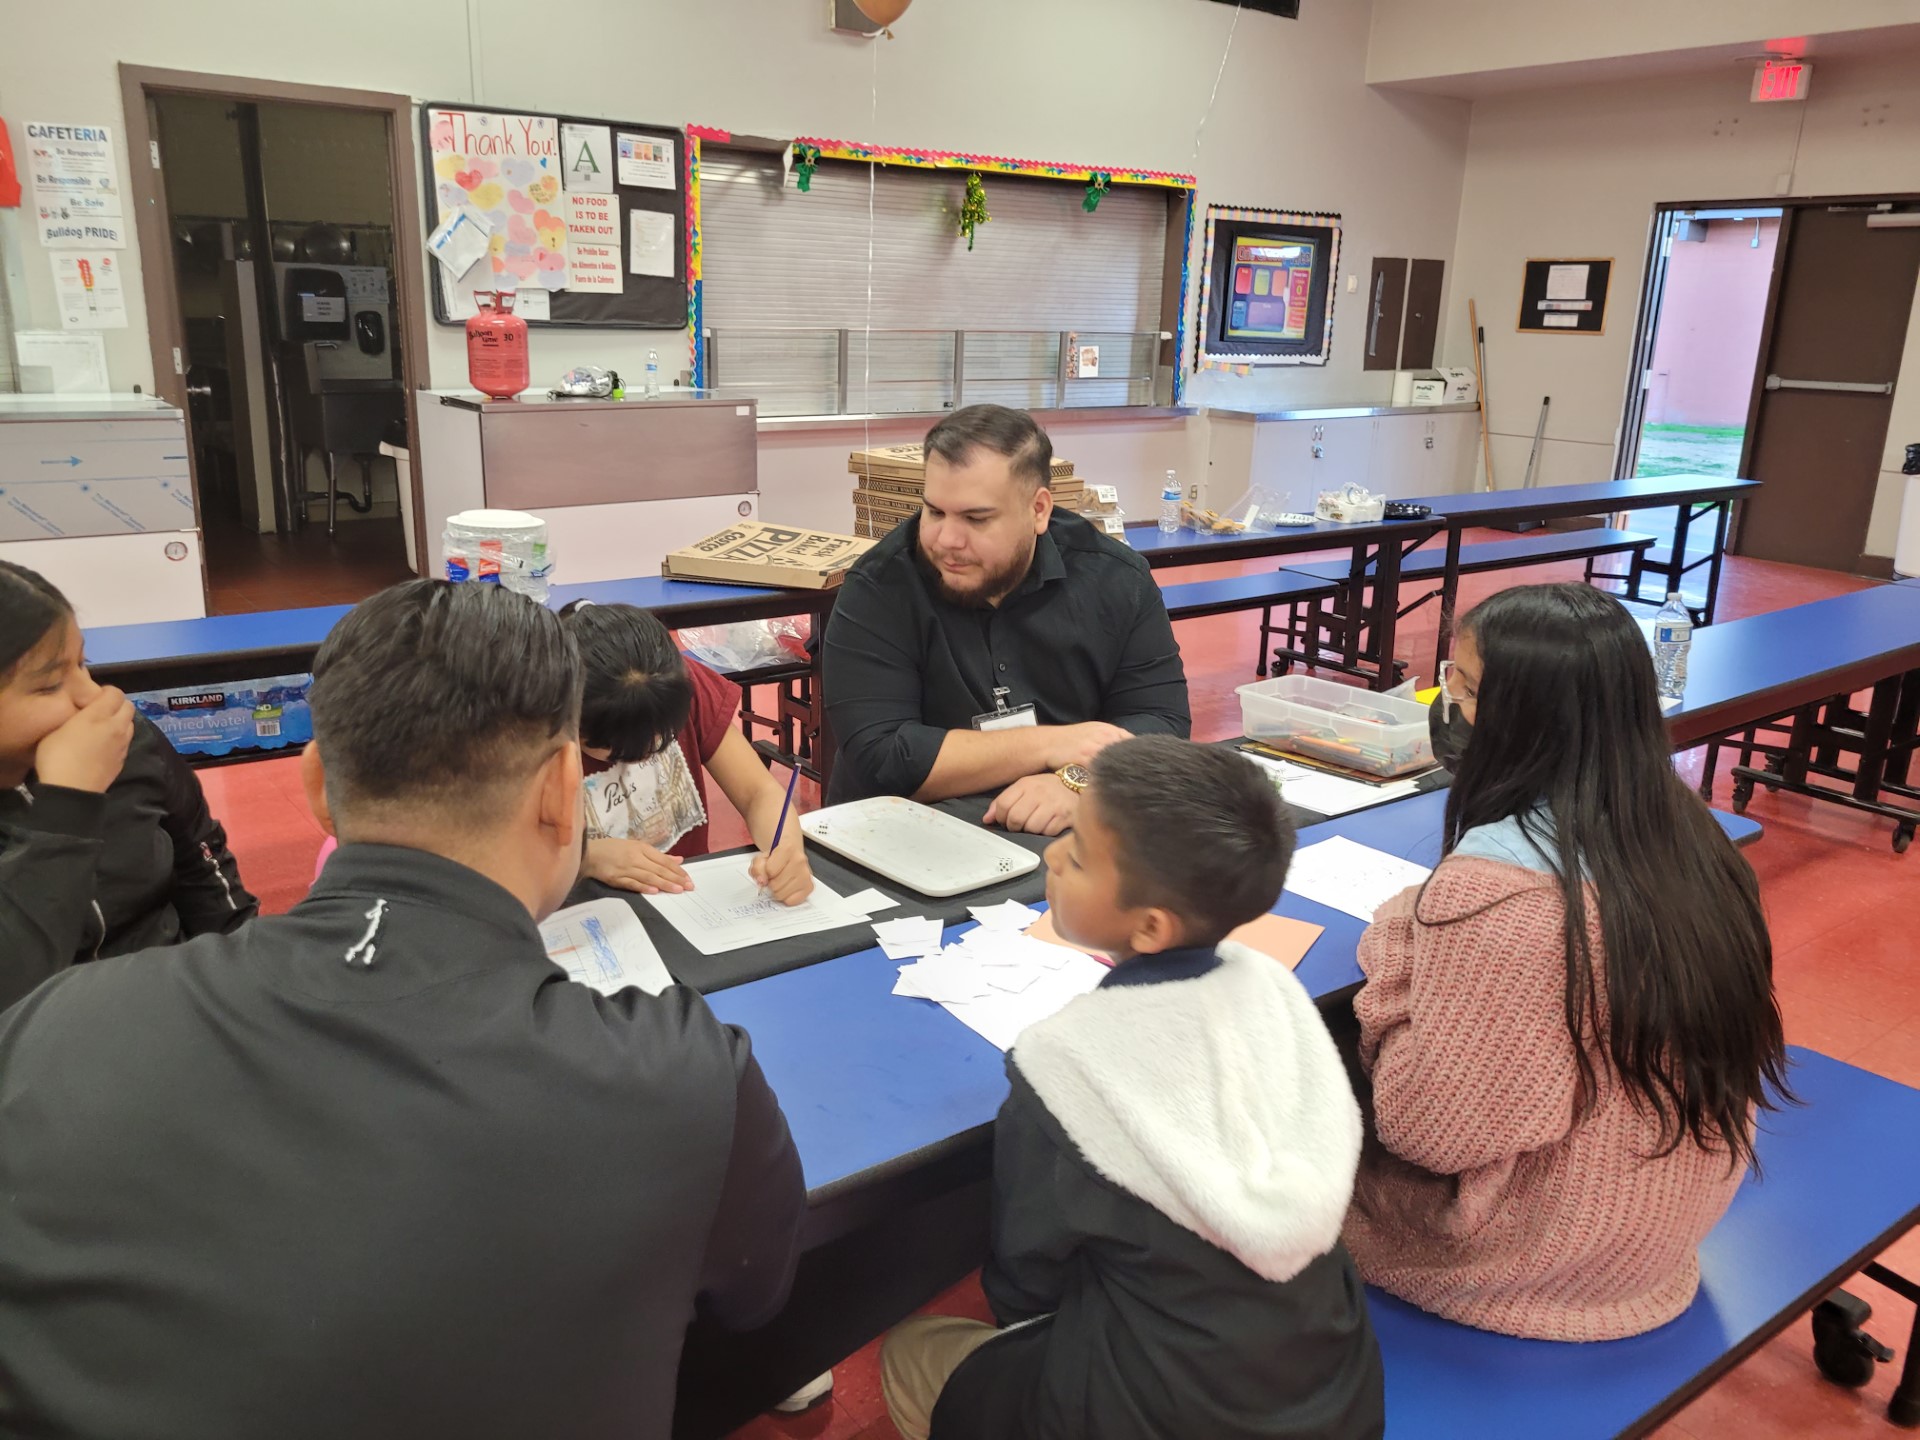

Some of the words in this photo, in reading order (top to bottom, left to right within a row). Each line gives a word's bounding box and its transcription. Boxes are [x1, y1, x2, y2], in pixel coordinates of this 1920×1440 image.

[1760, 66, 1802, 100] EXIT
[27, 125, 108, 143] CAFETERIA
[437, 112, 517, 156] Thank
[517, 118, 557, 156] You!
[572, 140, 601, 174] A
[36, 174, 46, 184] Be
[48, 175, 92, 186] Responsible
[70, 198, 82, 207] Be
[84, 199, 105, 208] Safe
[572, 196, 585, 205] NO
[586, 197, 608, 207] FOOD
[575, 210, 584, 220] IS
[586, 211, 597, 220] TO
[598, 212, 609, 221] BE
[46, 227, 83, 239] Bulldog
[568, 224, 596, 234] TAKEN
[597, 225, 614, 235] OUT
[468, 329, 493, 341] Balloon
[503, 333, 514, 342] 30
[700, 531, 746, 552] COSTCO
[709, 526, 802, 561] PIZZA
[171, 694, 223, 705] KIRKLAND
[160, 719, 204, 732] urified
[207, 716, 246, 729] water
